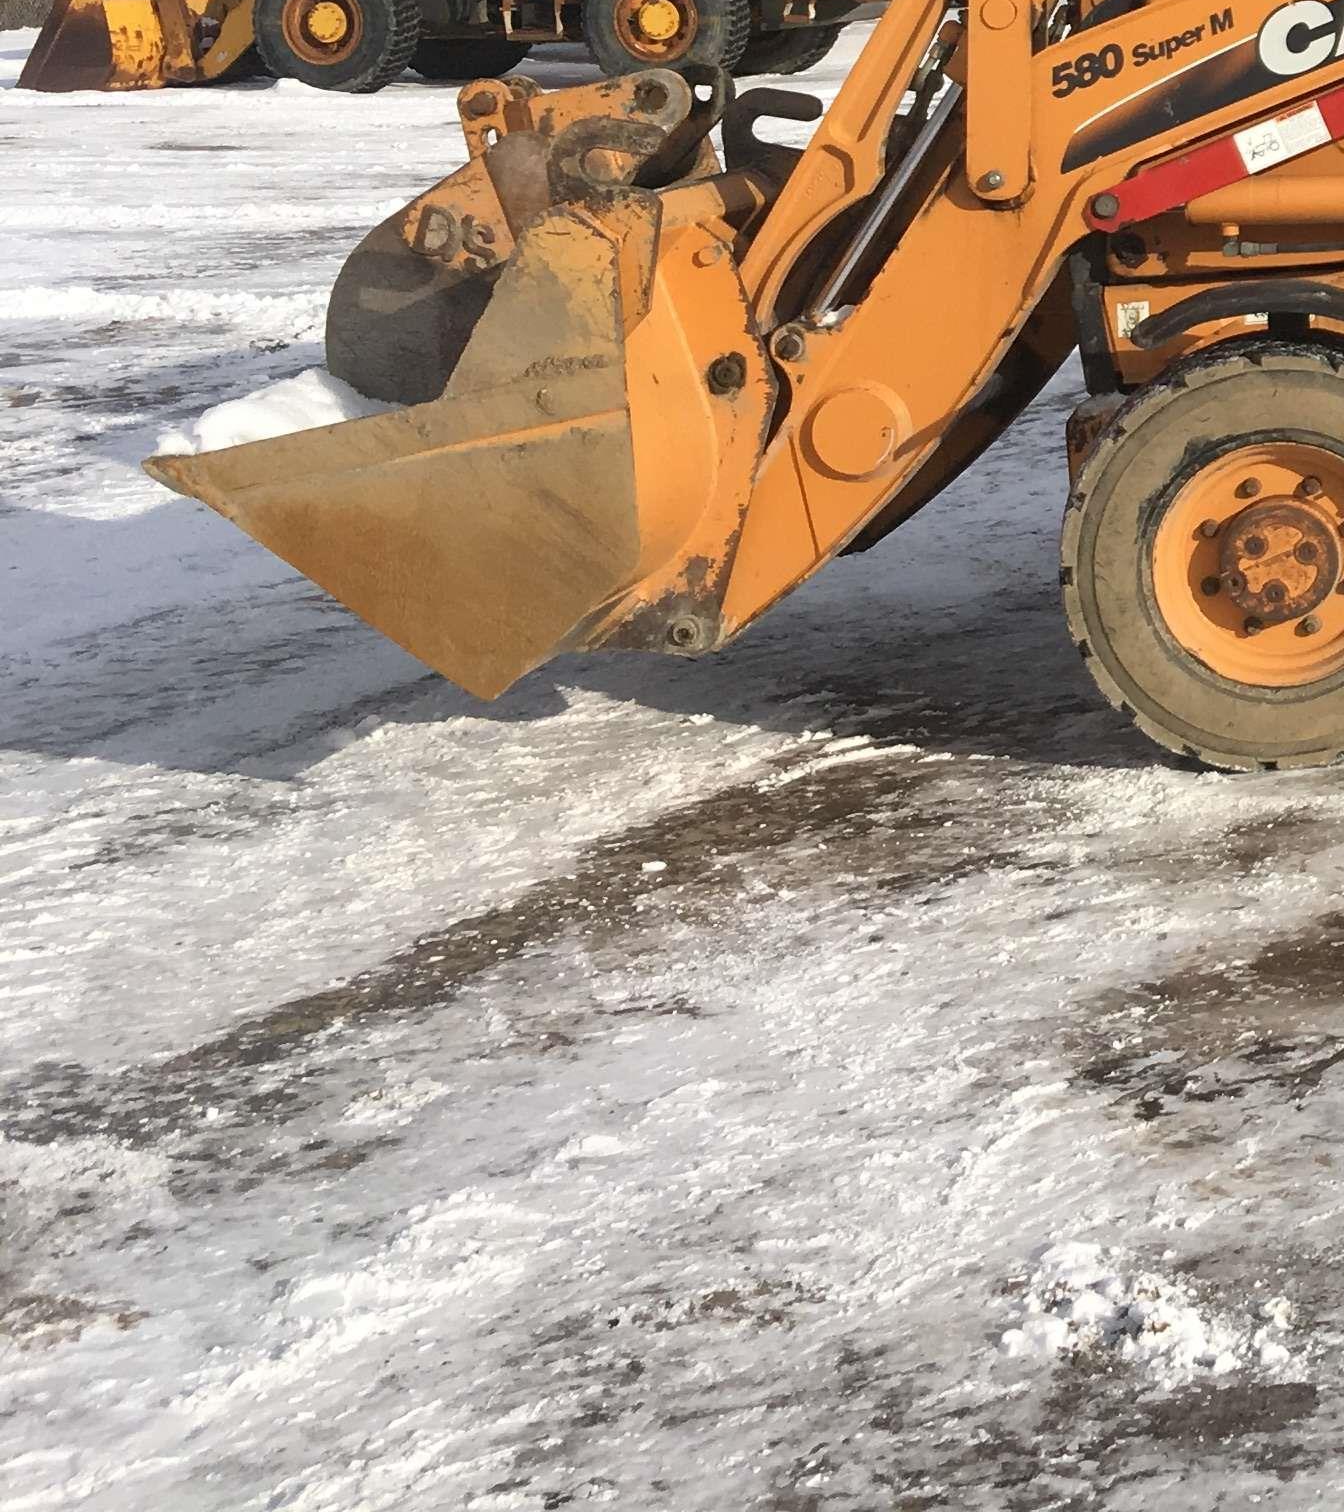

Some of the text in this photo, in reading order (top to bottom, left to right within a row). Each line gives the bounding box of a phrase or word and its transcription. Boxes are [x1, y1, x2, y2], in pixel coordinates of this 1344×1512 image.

[1052, 7, 1234, 99] 580 Super M
